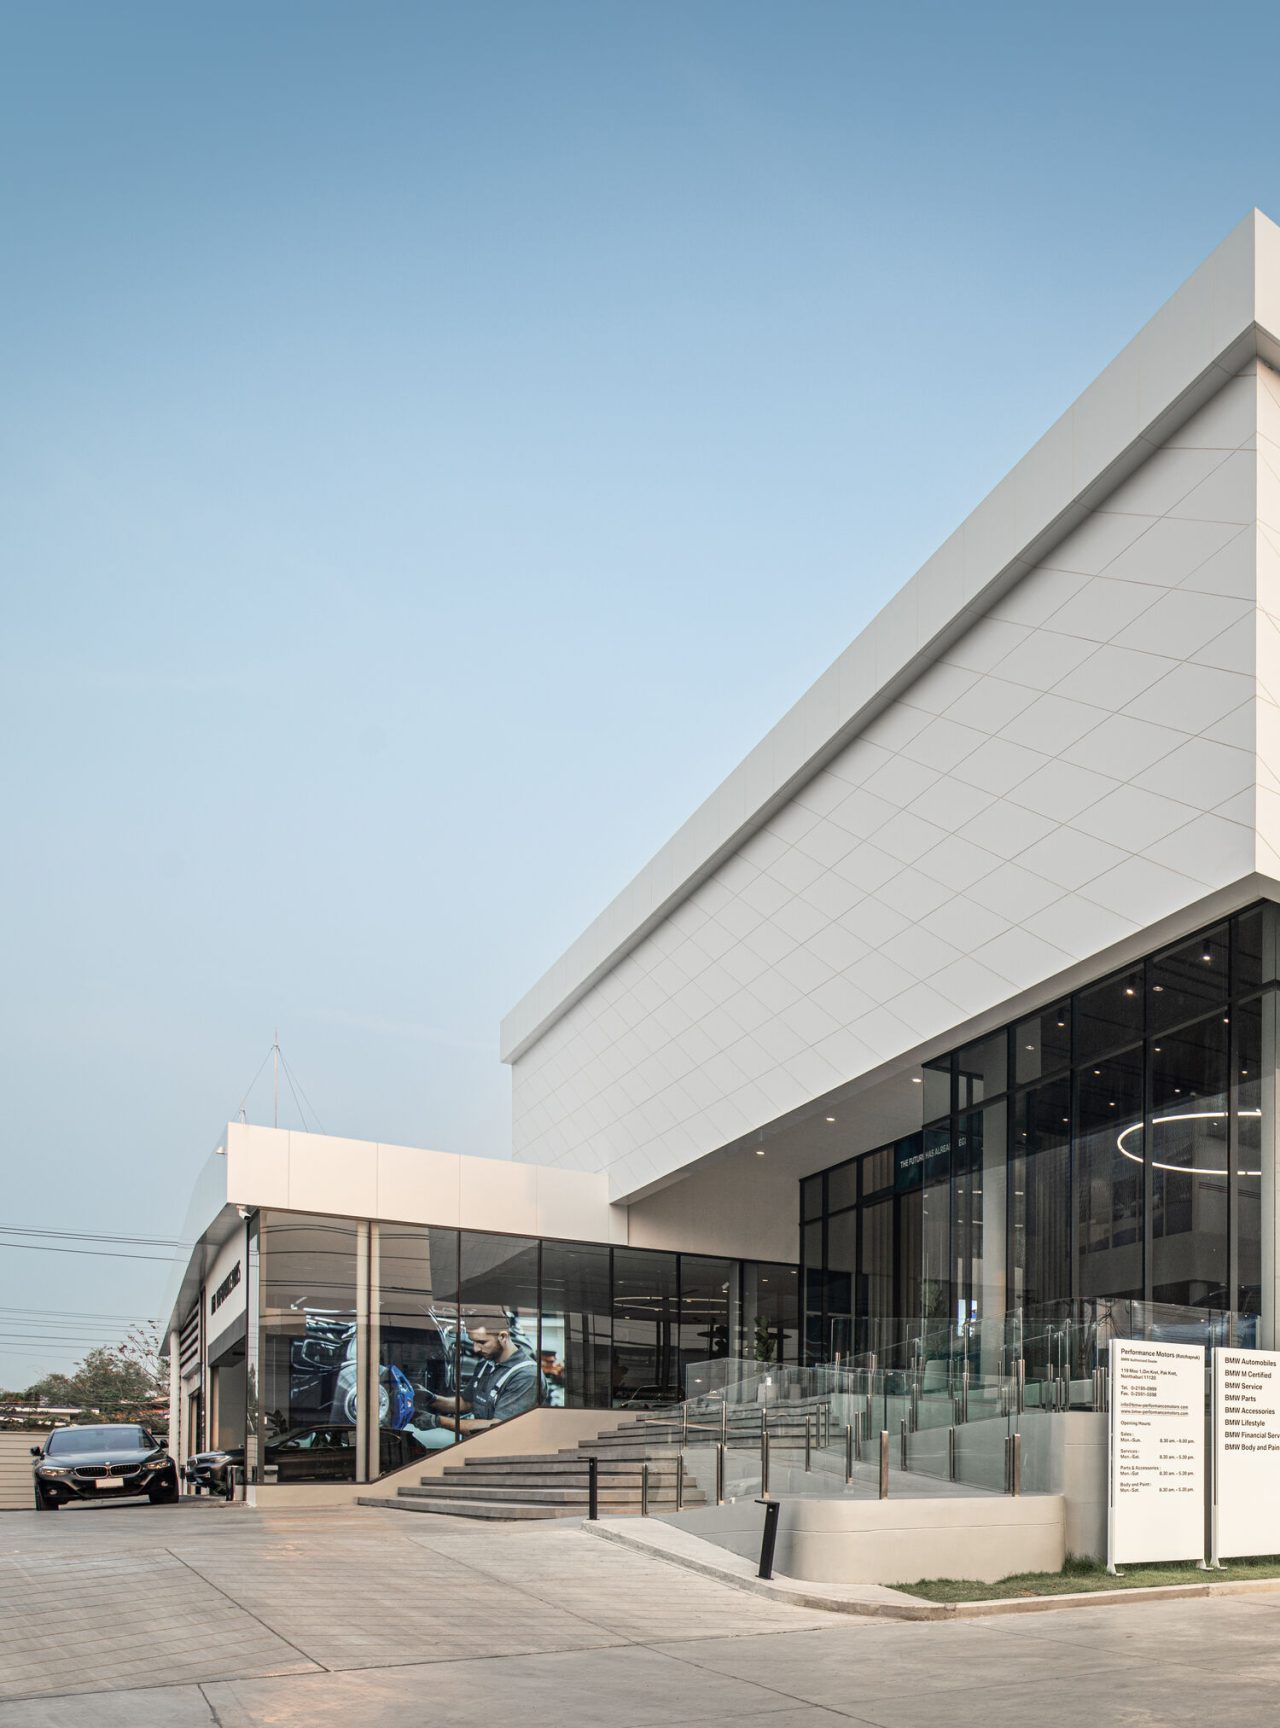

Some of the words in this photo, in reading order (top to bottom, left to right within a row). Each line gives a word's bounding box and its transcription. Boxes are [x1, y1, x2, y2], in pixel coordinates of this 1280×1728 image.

[1121, 1348, 1155, 1357] Performance
[1241, 1358, 1276, 1366] Automobiles
[1241, 1382, 1262, 1390] Service
[1242, 1444, 1256, 1452] Body
